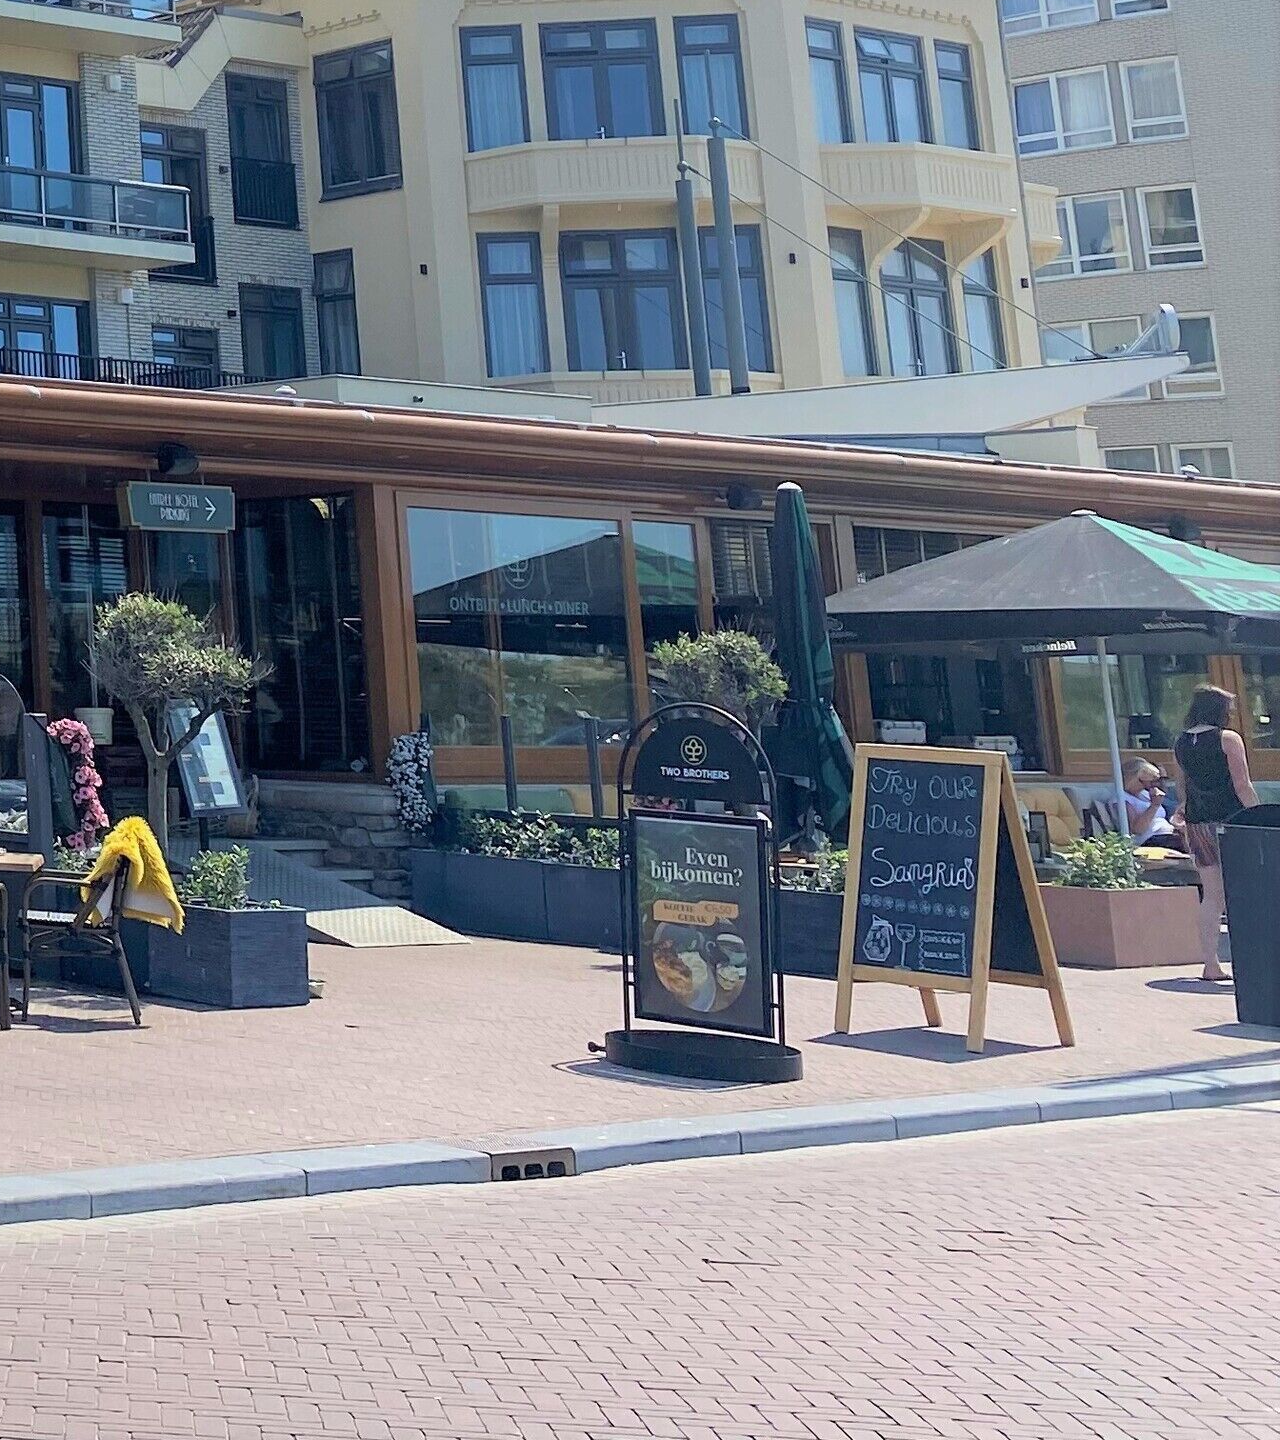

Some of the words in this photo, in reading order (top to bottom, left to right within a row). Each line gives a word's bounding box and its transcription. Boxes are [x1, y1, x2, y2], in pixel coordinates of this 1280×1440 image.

[449, 596, 499, 611] ONTBIJT
[506, 599, 550, 614] LUNCH
[553, 600, 590, 616] DINER
[660, 766, 681, 777] TWO
[682, 767, 730, 781] BROTHERS
[685, 846, 729, 868] Even
[650, 860, 744, 887] bijkomen?
